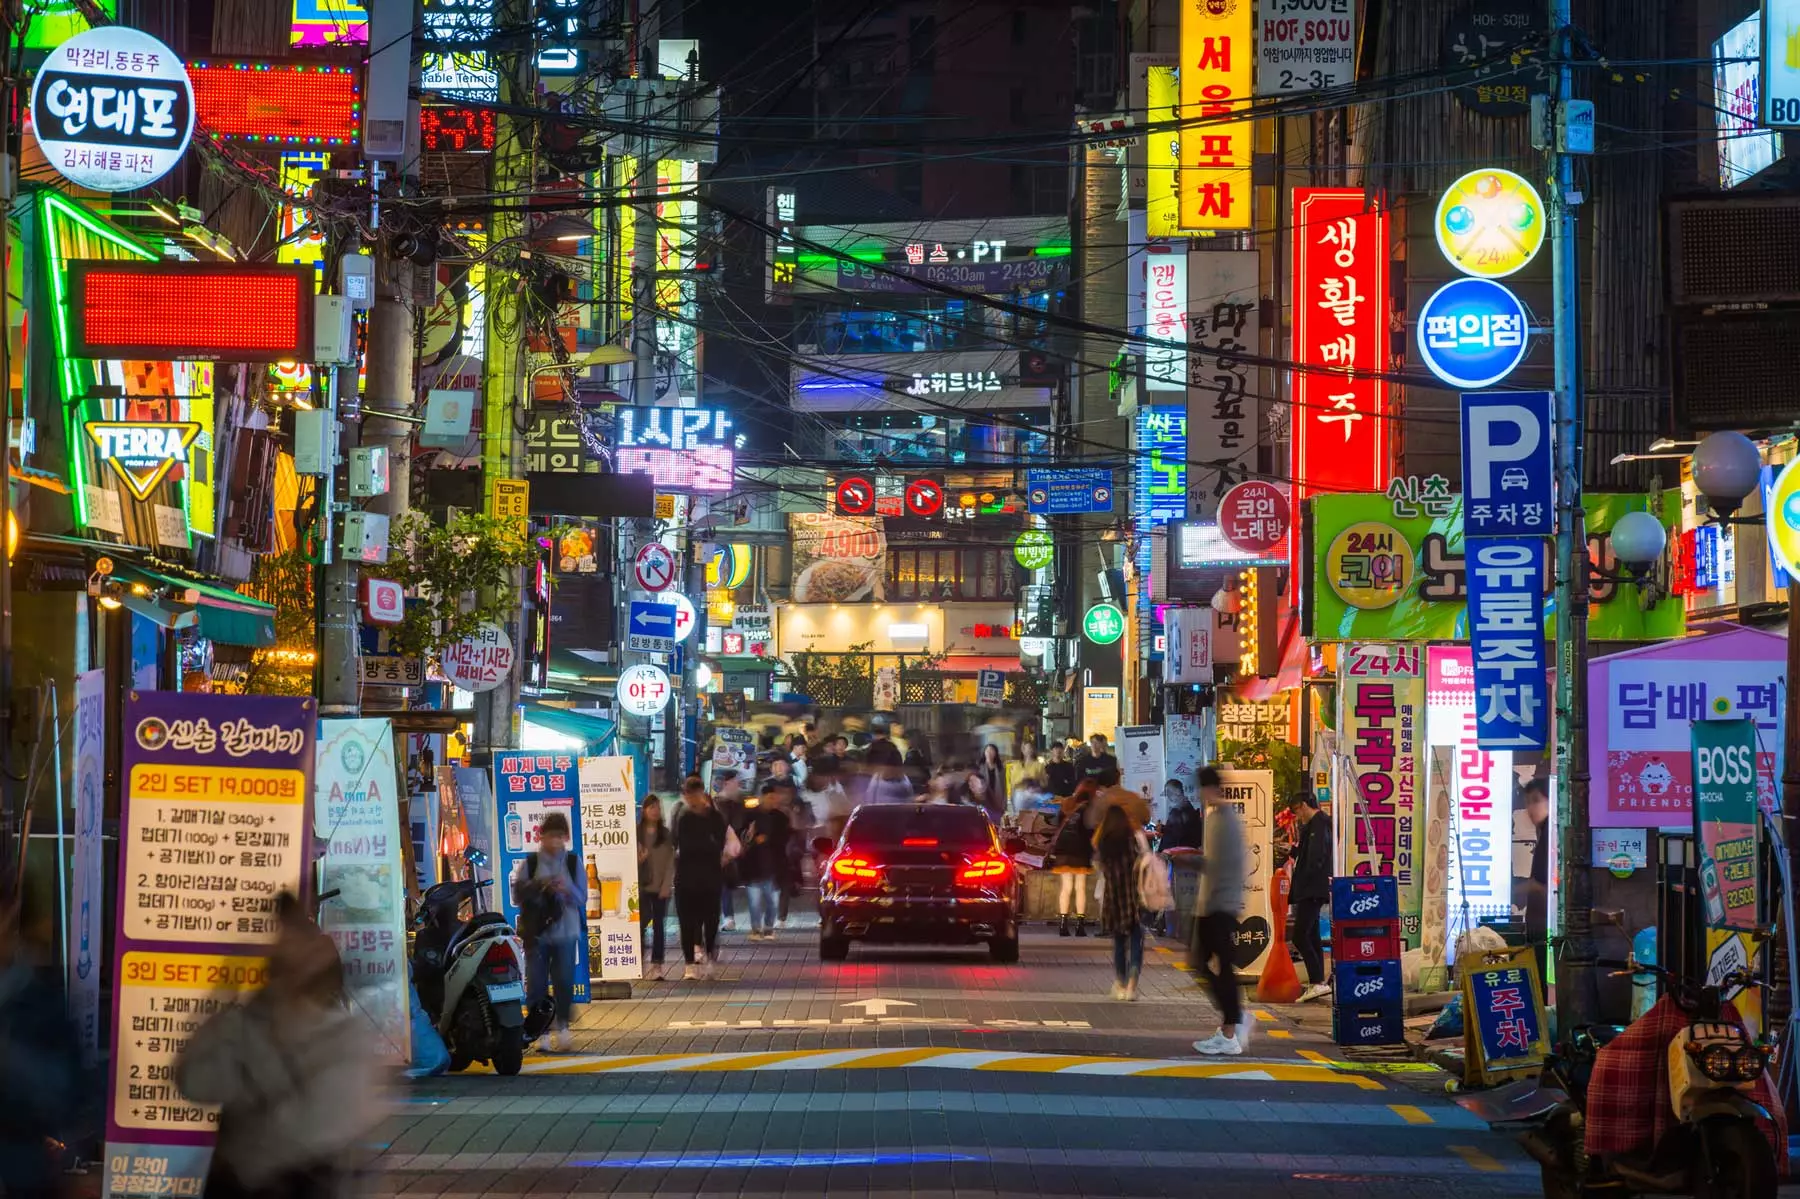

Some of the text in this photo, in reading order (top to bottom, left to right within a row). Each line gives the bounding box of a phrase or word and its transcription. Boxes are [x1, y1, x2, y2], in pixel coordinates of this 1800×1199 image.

[1263, 47, 1353, 64] 아침10시까지 영업합니다
[456, 72, 496, 84] Tennis
[1279, 69, 1336, 90] 2~3F
[45, 78, 179, 139] 연대포
[1197, 35, 1236, 220] 서울포차
[62, 147, 154, 174] 김치해물파전
[905, 243, 950, 265] 헬스
[973, 240, 1007, 263] PT
[1477, 247, 1511, 266] 24시
[927, 266, 985, 283] 06:30am
[1316, 216, 1365, 443] 생활맥주
[1426, 314, 1522, 348] 편의점
[618, 408, 732, 450] 1시간
[97, 428, 186, 460] TERRA
[1469, 404, 1541, 499] P
[1242, 486, 1267, 498] 24시
[1387, 473, 1453, 519] 신촌
[1236, 497, 1275, 520] 코인
[1470, 503, 1543, 527] 주차장
[1230, 517, 1284, 543] 노래방
[1018, 545, 1049, 559] 비빔밥
[1347, 532, 1394, 554] 24시
[1339, 553, 1404, 591] 코인
[1088, 619, 1119, 637] 부동산
[1475, 545, 1541, 728] 유료주차
[631, 636, 674, 651] 일방통행
[443, 644, 511, 669] 1시간+1시간
[1349, 645, 1420, 677] 24시
[455, 665, 498, 683] 써비스
[635, 669, 657, 681] 사격
[983, 671, 999, 687] P
[629, 683, 665, 699] 야구
[636, 700, 658, 712] 다트
[1221, 703, 1291, 723] 청정라거
[1618, 681, 1708, 730] 담배
[167, 717, 305, 757] 신촌 갈매기
[1400, 704, 1413, 754] 매일매일
[1698, 744, 1752, 786] BOSS
[138, 773, 168, 793] 2인
[173, 774, 213, 794] SET
[508, 774, 567, 793] 할인점
[581, 803, 627, 818] 가든 4병
[1618, 798, 1693, 808] FRIENDS
[157, 807, 264, 828] 1. 갈매기살 (340g)
[585, 818, 622, 830] 치즈나쵸
[140, 827, 290, 849] 껍데기 (100g) 된장찌개
[582, 830, 630, 849] 14,000
[159, 849, 283, 868] 공기밥(1) or 음료(1)
[1397, 816, 1413, 887] 업데이트
[137, 873, 276, 894] 2. 항아리삼겹살 (340g)
[137, 892, 179, 910] 껍데기
[181, 897, 216, 911] (100g)
[1349, 894, 1381, 917] Cass
[156, 914, 213, 930] 공기밥(1)
[215, 921, 232, 931] or
[607, 932, 633, 943] 피닉스
[607, 944, 633, 955] 최신형
[604, 956, 637, 967] 2대 완비
[127, 961, 203, 983] 3인 SET
[1484, 968, 1523, 987] 유료
[1353, 976, 1385, 999] Cass
[149, 997, 159, 1012] 1.
[131, 1015, 173, 1032] 껍데기
[1490, 988, 1532, 1050] 주차
[1360, 1024, 1383, 1039] Cass
[129, 1065, 143, 1080] 2.
[128, 1083, 170, 1101] 껍데기
[144, 1106, 204, 1123] 공기밥(2)
[110, 1155, 169, 1175] 이 맛이
